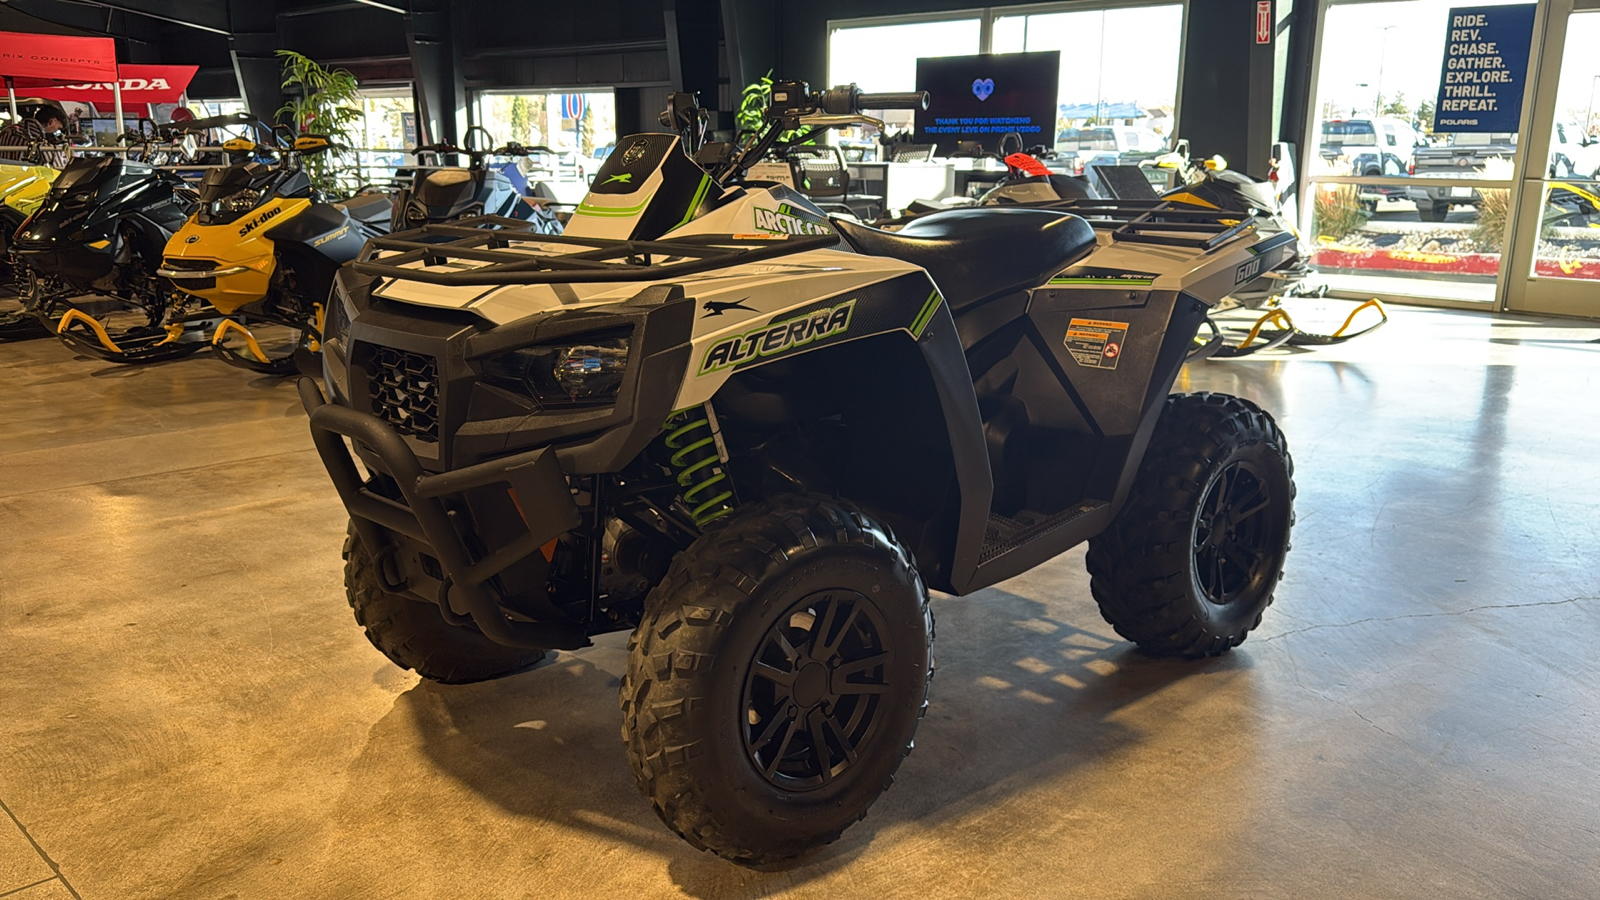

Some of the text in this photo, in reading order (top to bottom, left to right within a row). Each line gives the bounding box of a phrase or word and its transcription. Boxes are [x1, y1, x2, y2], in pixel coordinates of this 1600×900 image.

[1453, 14, 1488, 28] RIDE.
[1451, 29, 1481, 42] REV.
[1449, 42, 1499, 56] CHASE.
[30, 55, 101, 65] CONCEPTS
[1447, 56, 1506, 70] GATHER.
[1445, 70, 1513, 84] EXPLORE.
[1444, 85, 1496, 98] THRILL.
[1442, 99, 1498, 112] REPEAT.
[990, 117, 1032, 125] WATCHING
[239, 206, 282, 238] ski-doo
[754, 207, 831, 235] ARCTIC CAT
[313, 225, 350, 248] SUMMIT
[1236, 258, 1261, 283] 600
[703, 304, 851, 371] ALTERRA
